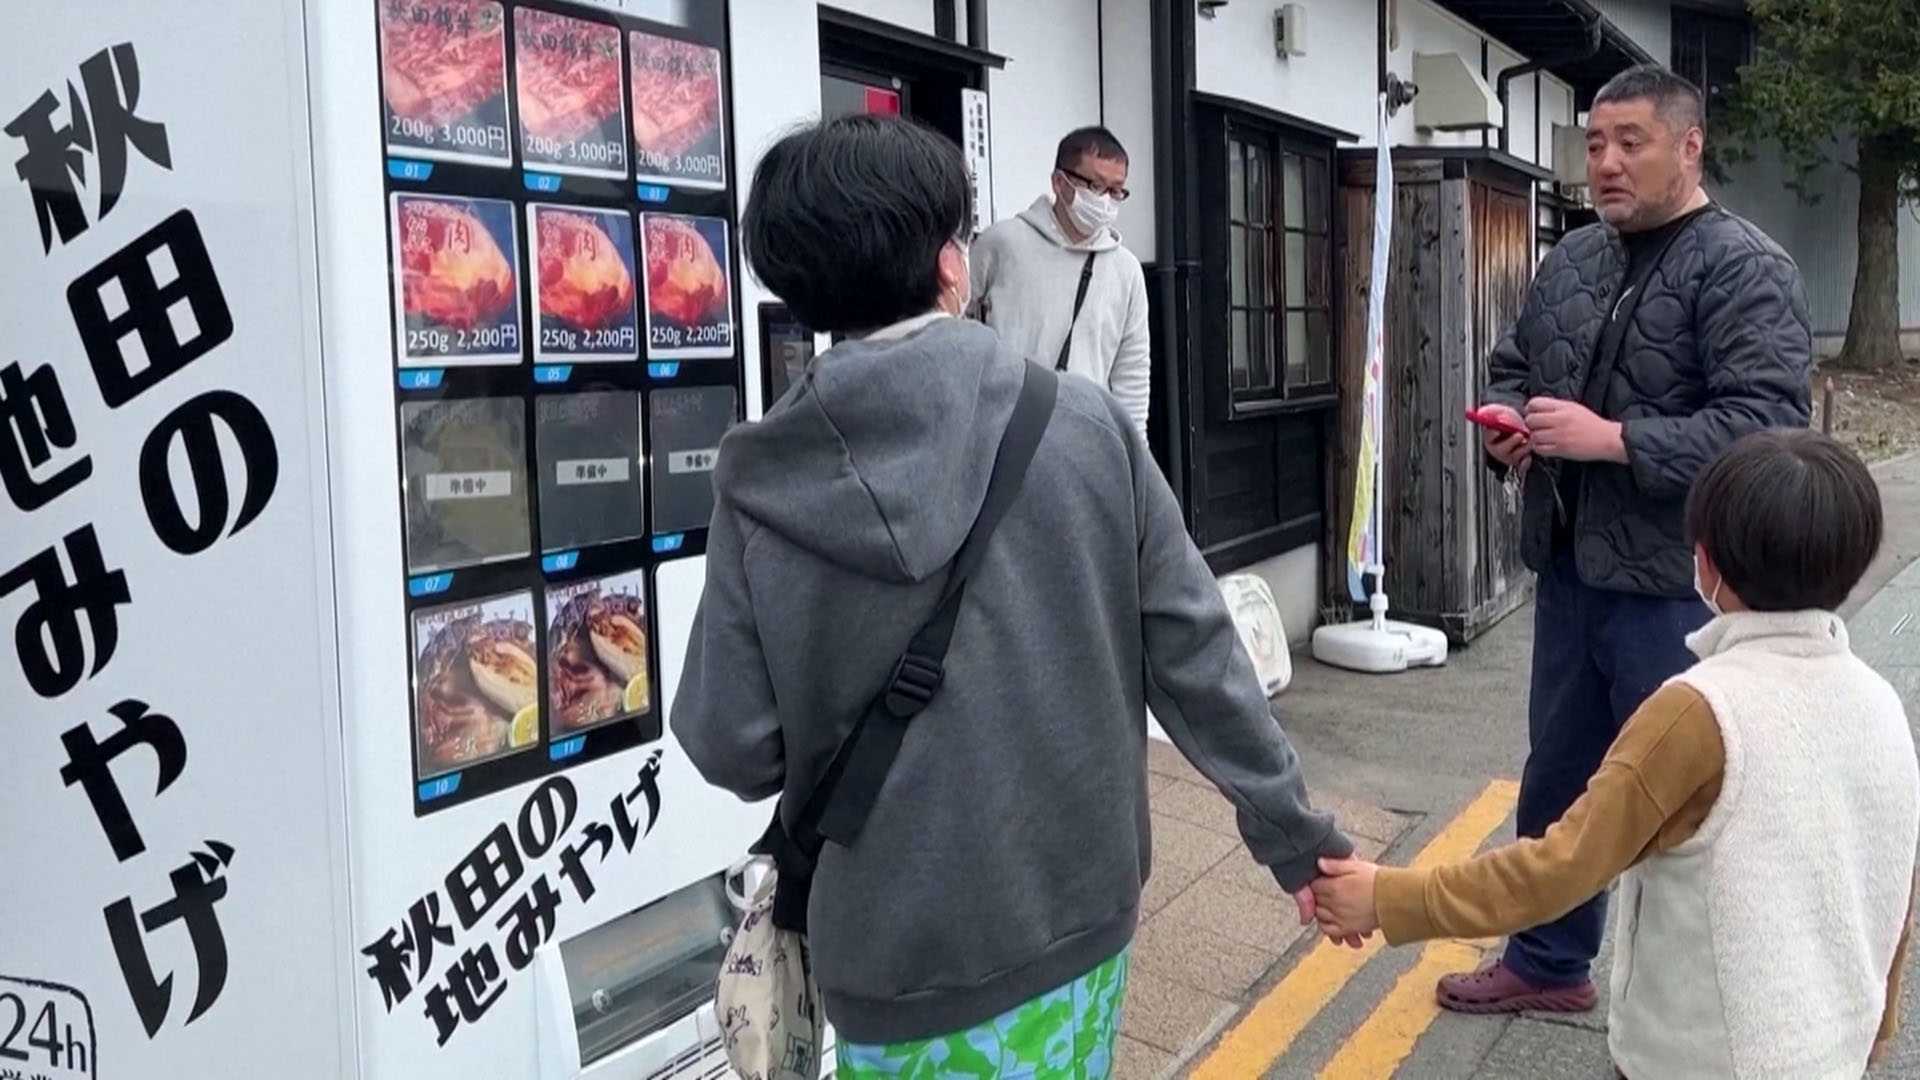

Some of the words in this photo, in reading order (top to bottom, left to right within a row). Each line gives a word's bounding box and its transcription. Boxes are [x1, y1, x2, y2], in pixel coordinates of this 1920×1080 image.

[393, 115, 434, 142] 200g
[442, 124, 506, 150] 3,000円
[526, 136, 562, 158] 200g
[569, 141, 623, 164] 3,000円
[638, 149, 670, 172] 200g
[674, 153, 721, 175] 3,000円
[404, 164, 419, 177] 01
[537, 177, 550, 189] 02
[4, 41, 279, 555] 秋田の
[408, 329, 449, 352] 250g
[457, 327, 517, 349] 2,200円
[542, 329, 577, 350] 250g
[583, 327, 635, 349] 2,200円
[652, 326, 682, 346] 250g
[686, 323, 730, 344] 2,200円
[547, 369, 560, 380] 05
[659, 364, 672, 376] 06
[415, 372, 430, 385] 04
[685, 453, 711, 468] 準備中
[575, 463, 608, 479] 準備中
[555, 556, 569, 569] 08
[424, 578, 441, 593] 07
[563, 743, 575, 755] 11
[436, 780, 449, 793] 10
[361, 775, 579, 1014] 秋田の
[424, 748, 664, 1048] 地みやげ
[0, 992, 87, 1072] 24h
